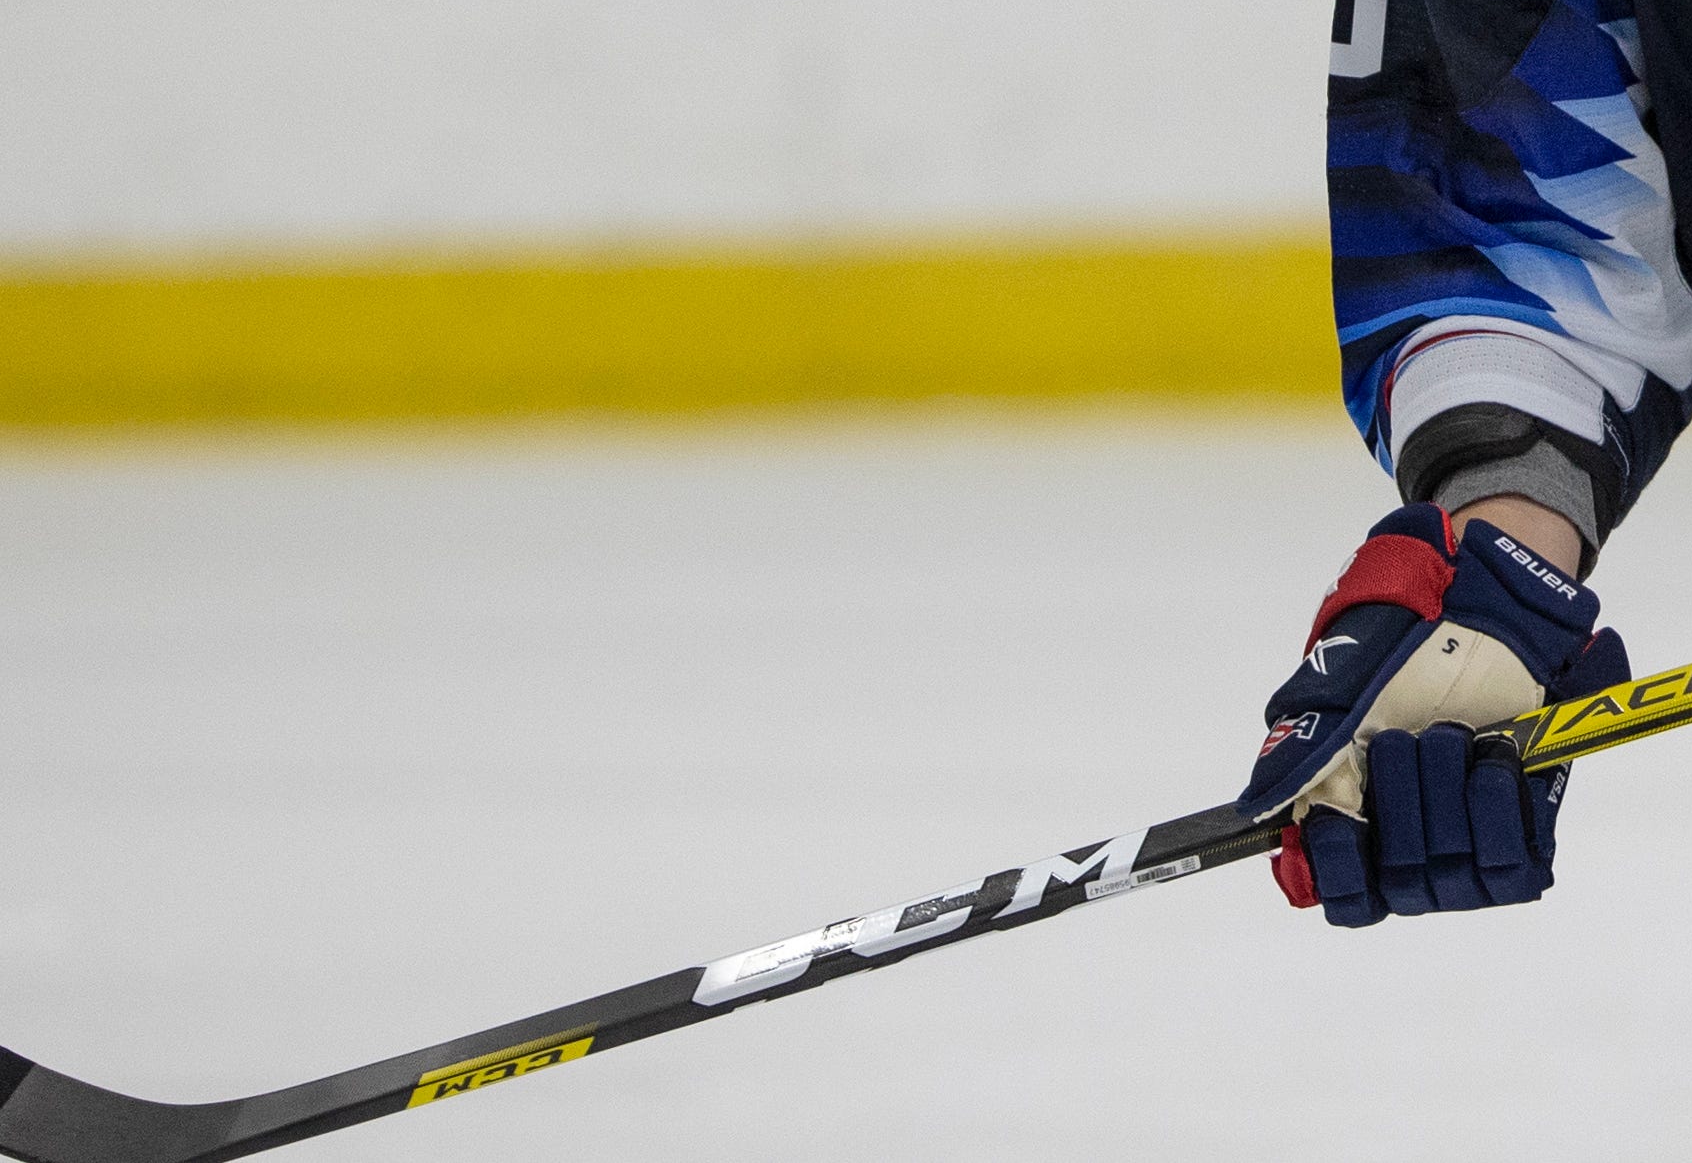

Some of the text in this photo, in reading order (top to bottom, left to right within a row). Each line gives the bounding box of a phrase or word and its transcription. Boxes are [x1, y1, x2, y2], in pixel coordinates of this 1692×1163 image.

[1494, 536, 1577, 601] BAUER
[692, 826, 1151, 1007] CCM
[432, 1048, 565, 1101] CCM
